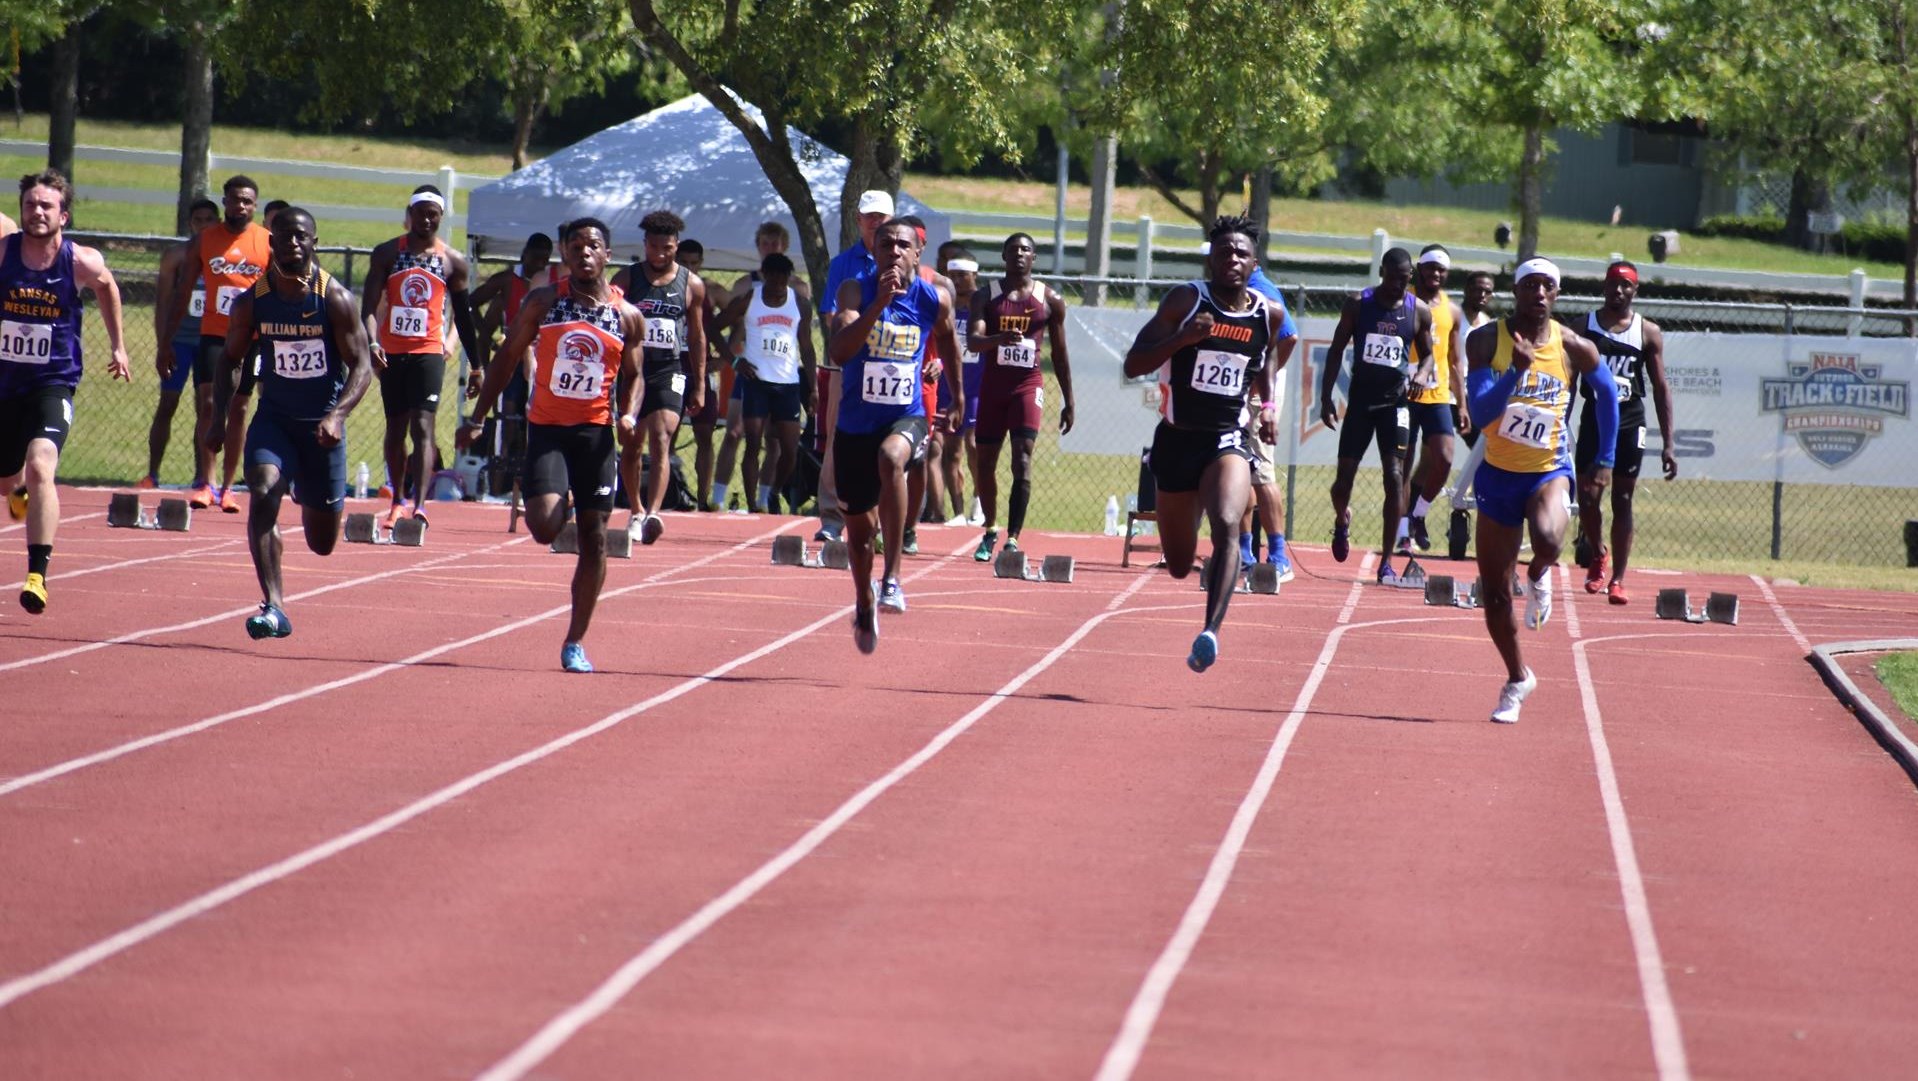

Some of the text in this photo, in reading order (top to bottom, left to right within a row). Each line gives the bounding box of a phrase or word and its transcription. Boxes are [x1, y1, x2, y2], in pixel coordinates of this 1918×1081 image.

[209, 256, 262, 275] Baker
[9, 288, 58, 305] KANSAS
[4, 301, 62, 318] WESLEYAN
[260, 322, 323, 336] WILLIAM PENN
[395, 316, 421, 332] 978
[1000, 316, 1031, 332] HTU
[1210, 323, 1253, 342] UNION
[643, 328, 673, 343] 158
[1, 334, 49, 357] 1010
[763, 338, 789, 353] 1016
[1366, 343, 1400, 361] 1243
[277, 351, 325, 371] 1323
[1003, 348, 1029, 362] 964
[1813, 354, 1857, 372] NAIA
[559, 372, 594, 392] 971
[1195, 363, 1240, 388] 1261
[1683, 377, 1722, 387] BEACH
[866, 376, 912, 397] 1173
[1764, 381, 1833, 409] TRACK
[1844, 384, 1905, 413] FIELD
[1508, 415, 1546, 441] 710
[1787, 415, 1880, 431] CHAMPIONSHIPS
